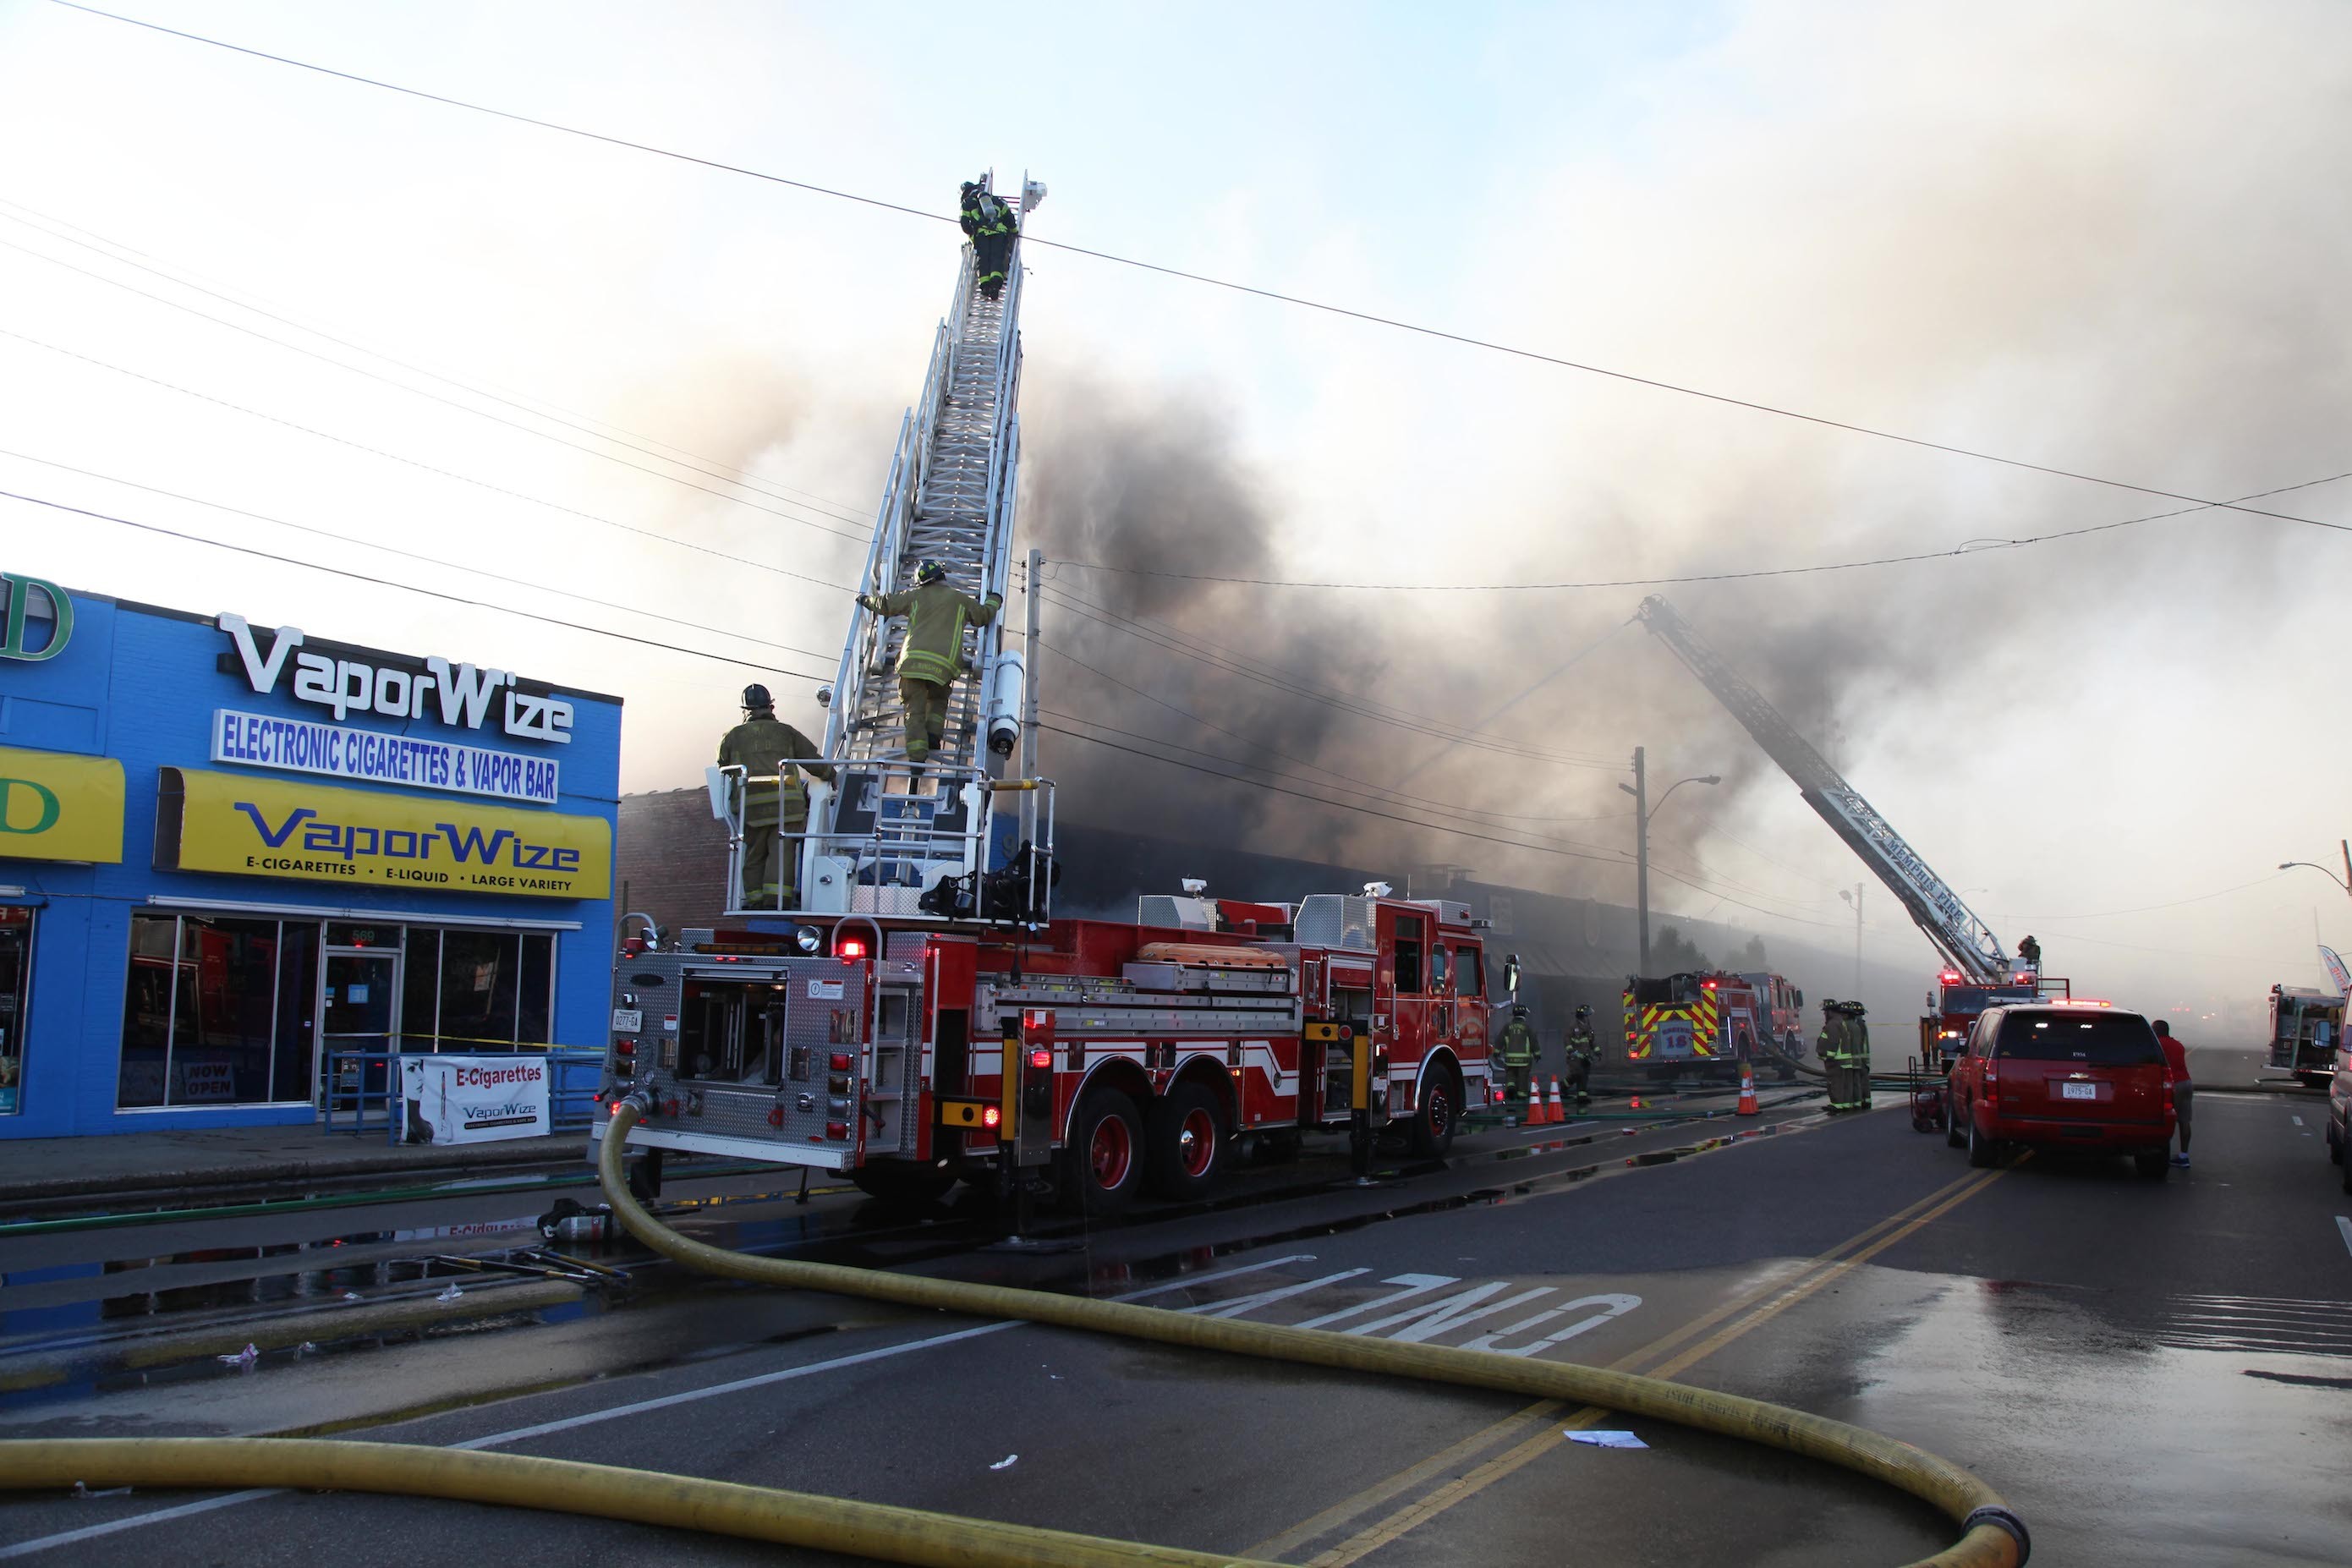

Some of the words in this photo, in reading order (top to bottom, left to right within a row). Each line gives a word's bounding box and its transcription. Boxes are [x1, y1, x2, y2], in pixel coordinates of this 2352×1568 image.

[0, 572, 74, 661] D
[217, 611, 573, 744] VaporWize
[223, 715, 339, 771] ELECTRONIC
[345, 732, 449, 787] CIGARETTES
[455, 750, 466, 788] &
[472, 753, 520, 796] VAPOR
[525, 759, 556, 800] BAR
[0, 777, 61, 835] D
[233, 802, 580, 873] VaporWize
[247, 856, 356, 875] E-CIGARETTES
[387, 868, 449, 883] E-LIQUID
[472, 874, 515, 887] LARGE
[519, 877, 573, 891] VARIETY
[1887, 839, 1938, 891] MEMPHIS
[1937, 891, 1964, 920] FIRE
[352, 930, 376, 942] 569
[188, 1082, 231, 1095] OPEN
[189, 1066, 228, 1078] NOW
[457, 1065, 541, 1088] E-Cigarettes
[463, 1103, 536, 1120] VaporWize
